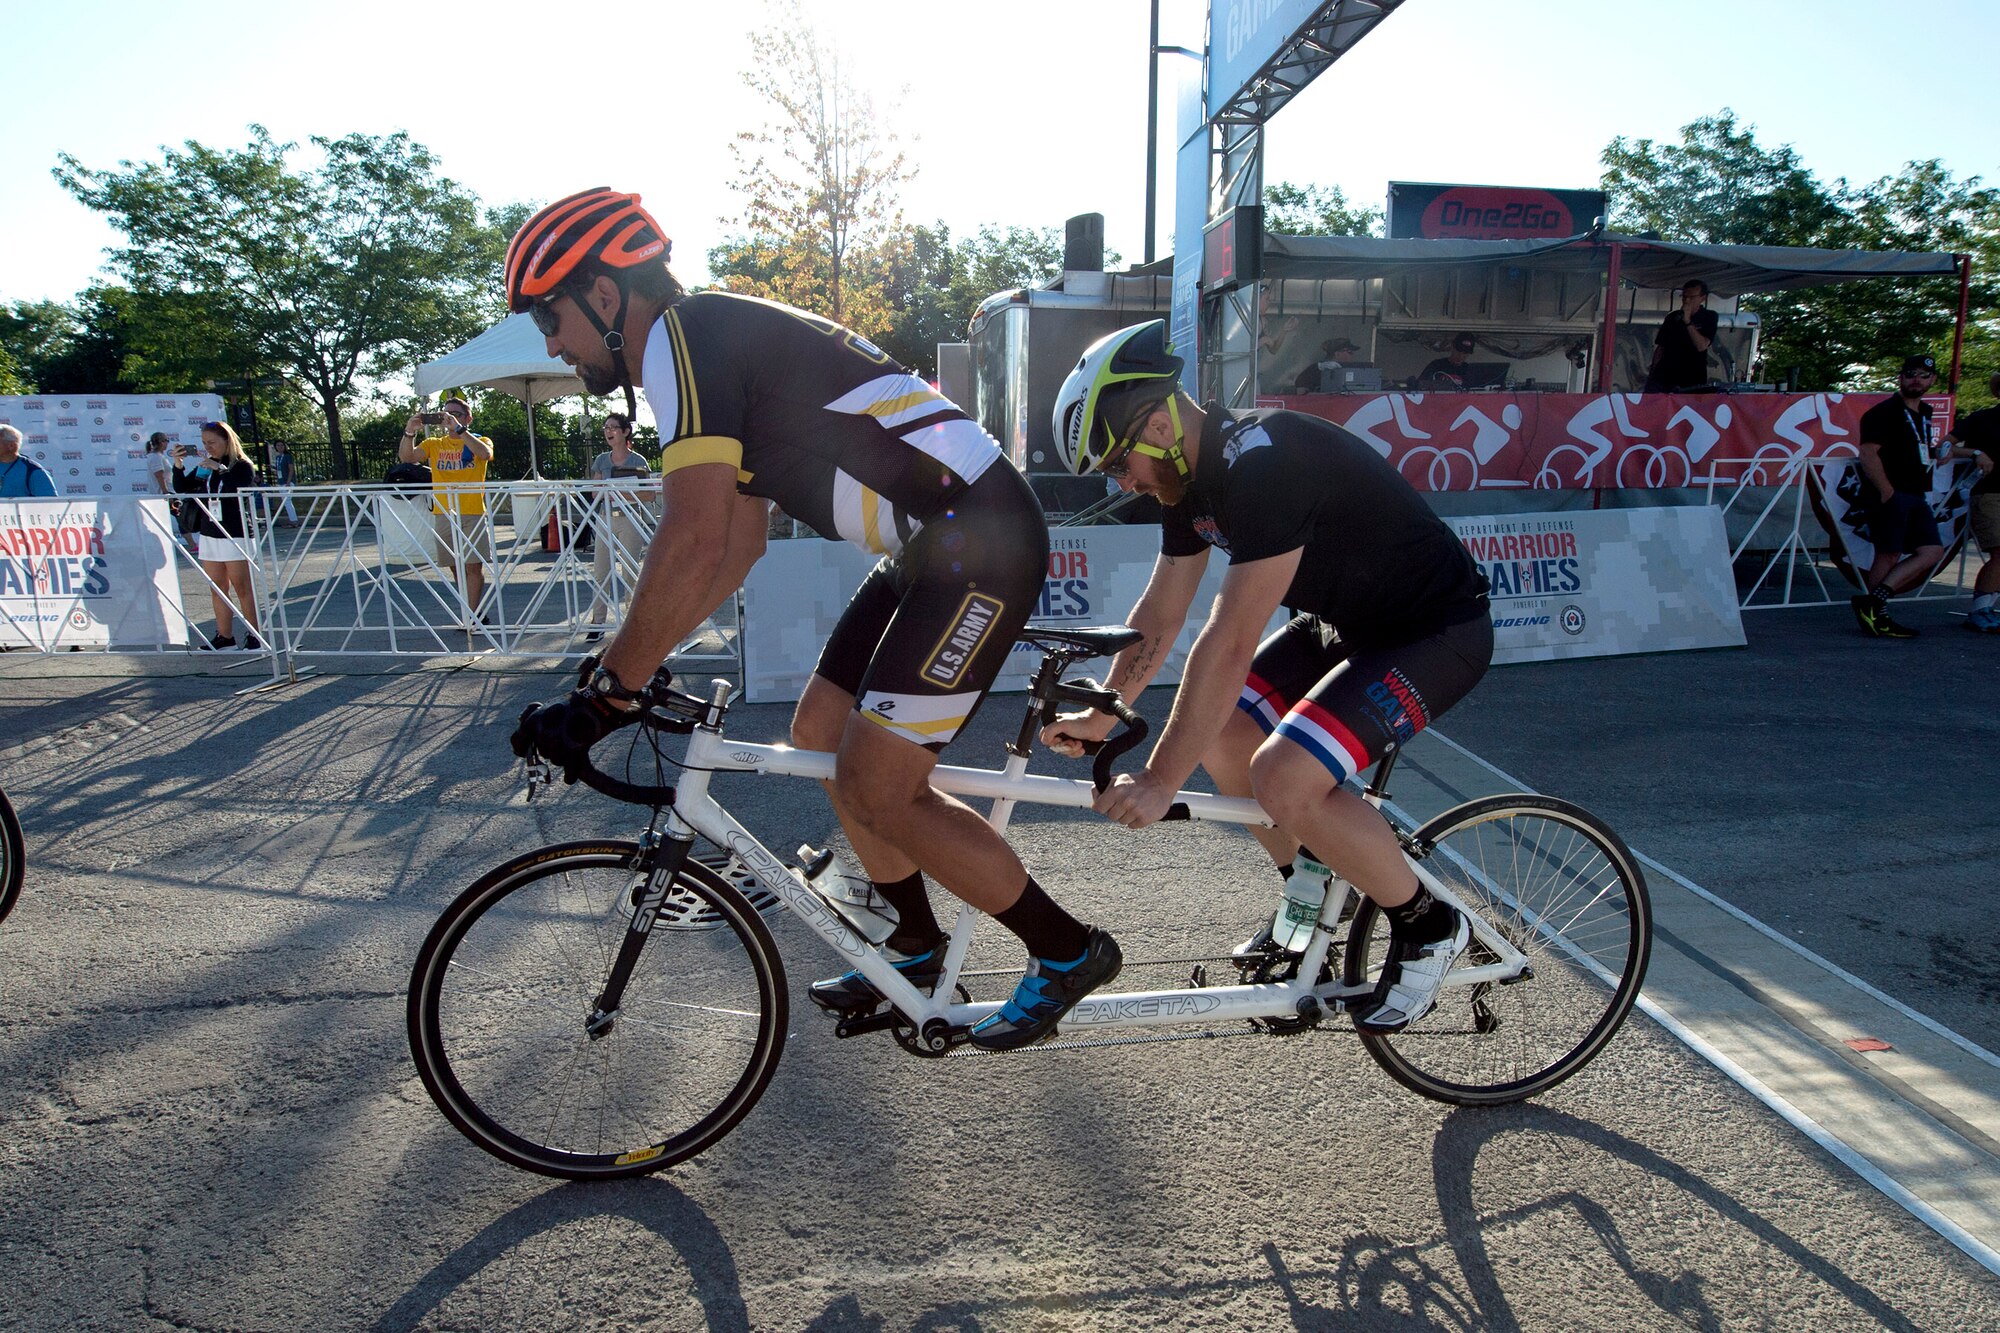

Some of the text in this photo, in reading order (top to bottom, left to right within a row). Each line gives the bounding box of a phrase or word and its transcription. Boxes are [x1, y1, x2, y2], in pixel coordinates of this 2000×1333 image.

[1439, 200, 1560, 229] One2Go
[530, 232, 557, 273] LAZER
[1070, 386, 1088, 455] S-WORKS
[30, 514, 41, 525] OF
[1460, 520, 1575, 535] DEPARTMENT OF DEFENSE
[0, 527, 105, 555] RRIOR
[1462, 532, 1577, 561] WARRIOR
[0, 557, 110, 595] AMES
[1477, 558, 1580, 596] AMES
[1513, 600, 1538, 609] POWERED
[1492, 615, 1550, 628] BOEING
[1365, 681, 1416, 745] GAME
[1382, 671, 1426, 734] WARRIO
[742, 845, 855, 946] PAKETA
[1071, 996, 1200, 1022] PAKETA
